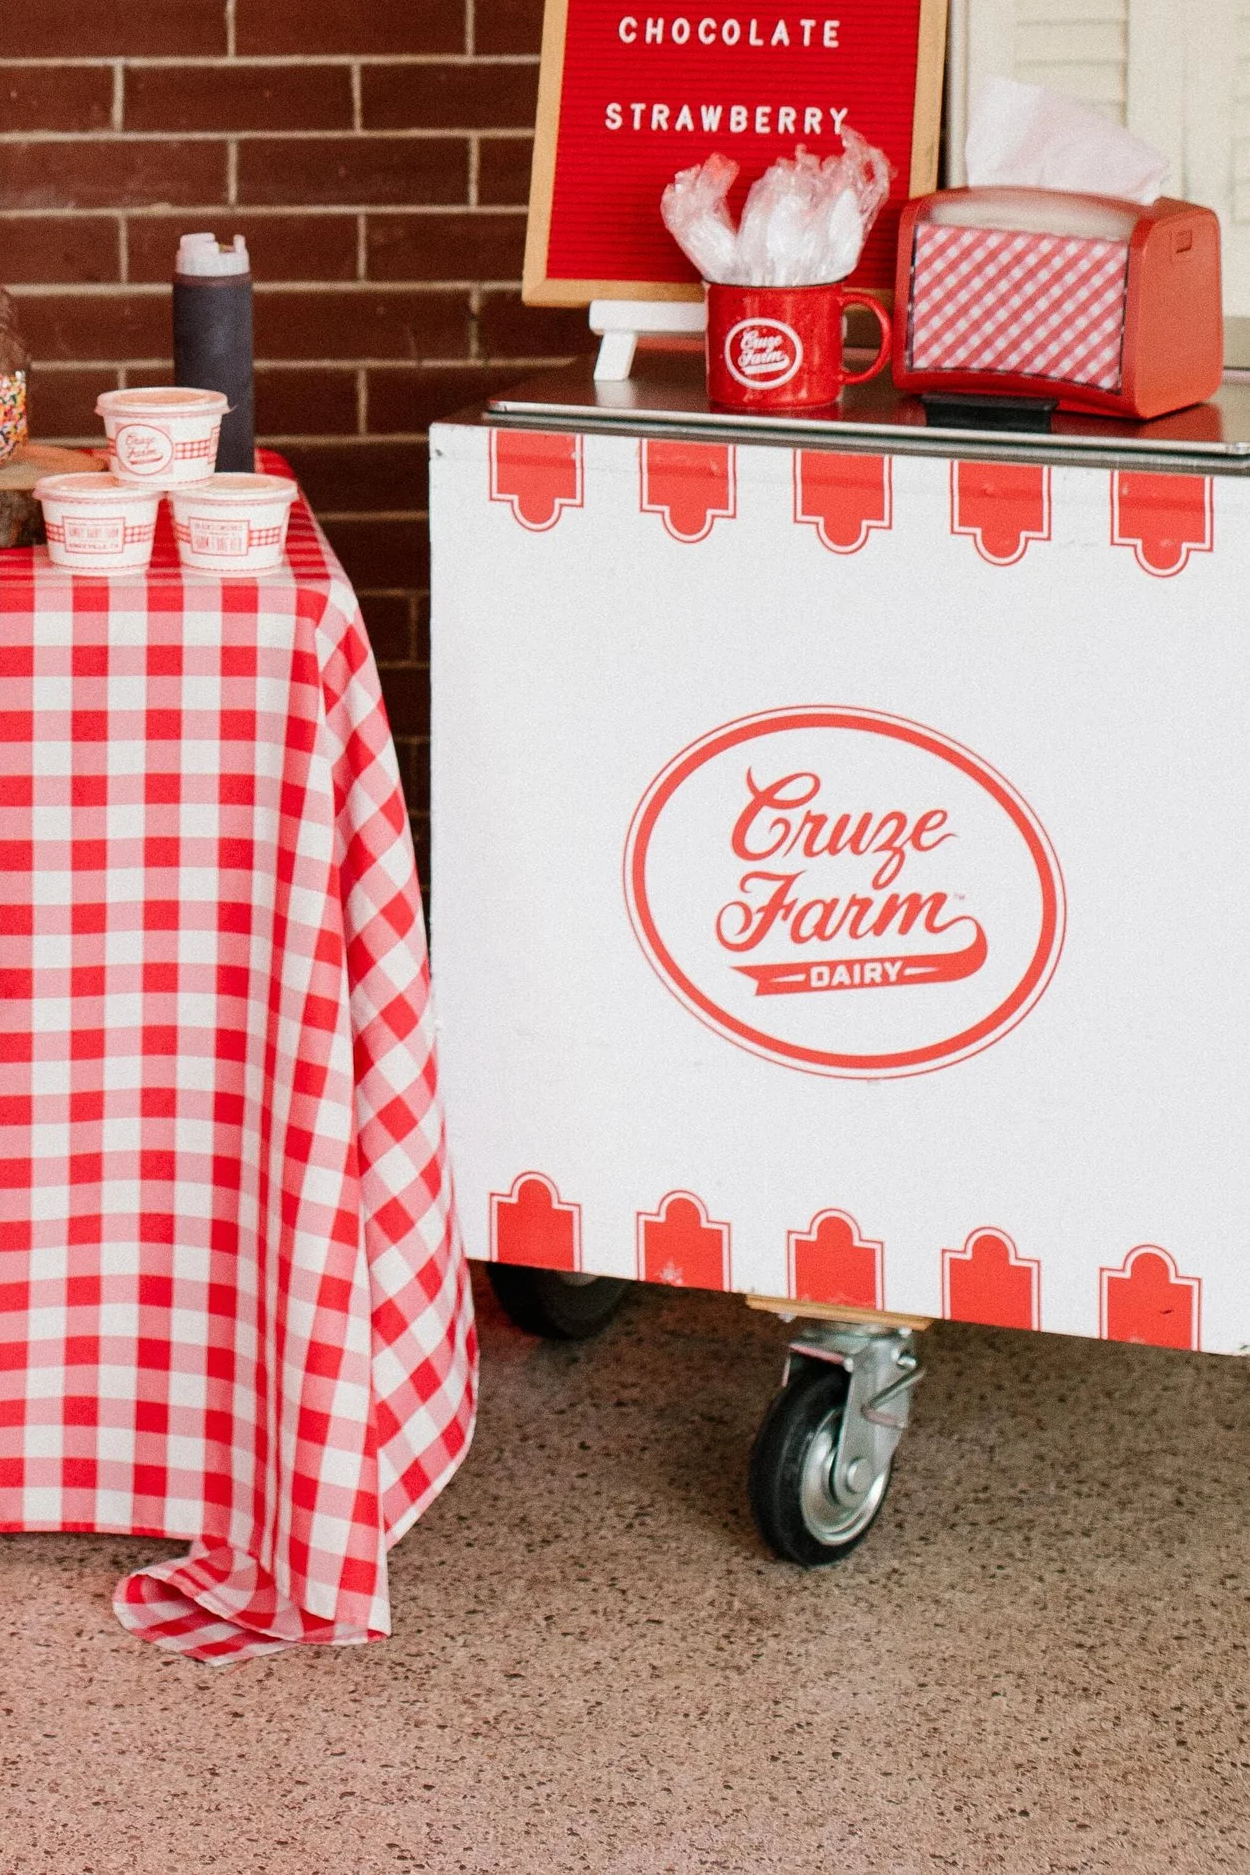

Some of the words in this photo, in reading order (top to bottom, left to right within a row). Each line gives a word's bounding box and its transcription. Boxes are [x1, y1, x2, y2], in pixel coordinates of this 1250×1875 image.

[618, 16, 841, 48] CHOCOLATE
[604, 102, 849, 135] STRAWBERRY
[730, 765, 958, 890] Cruze
[715, 869, 966, 953] Farm
[808, 959, 904, 989] DAIRY
